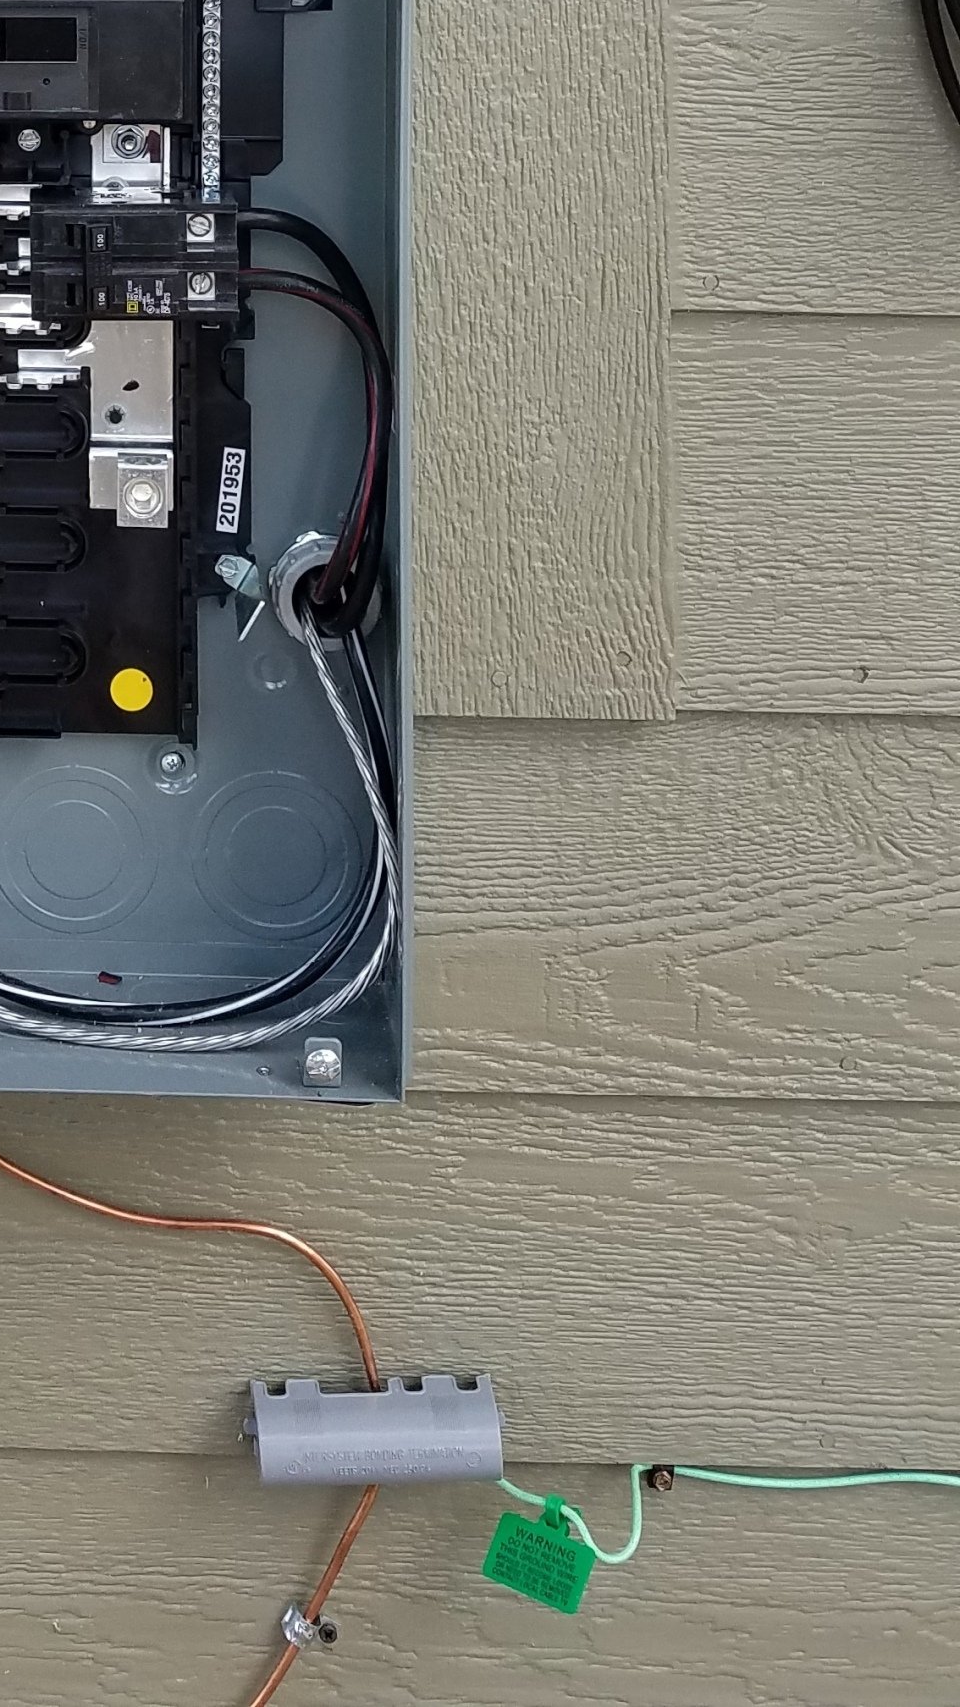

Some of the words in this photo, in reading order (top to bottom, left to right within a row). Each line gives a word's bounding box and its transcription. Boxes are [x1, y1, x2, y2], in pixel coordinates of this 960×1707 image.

[97, 233, 105, 247] 100
[98, 291, 106, 306] 100
[219, 451, 242, 527] 201953
[500, 1542, 519, 1555] THIS
[507, 1537, 521, 1548] DO
[522, 1543, 539, 1555] NOT
[516, 1526, 576, 1562] WARNING
